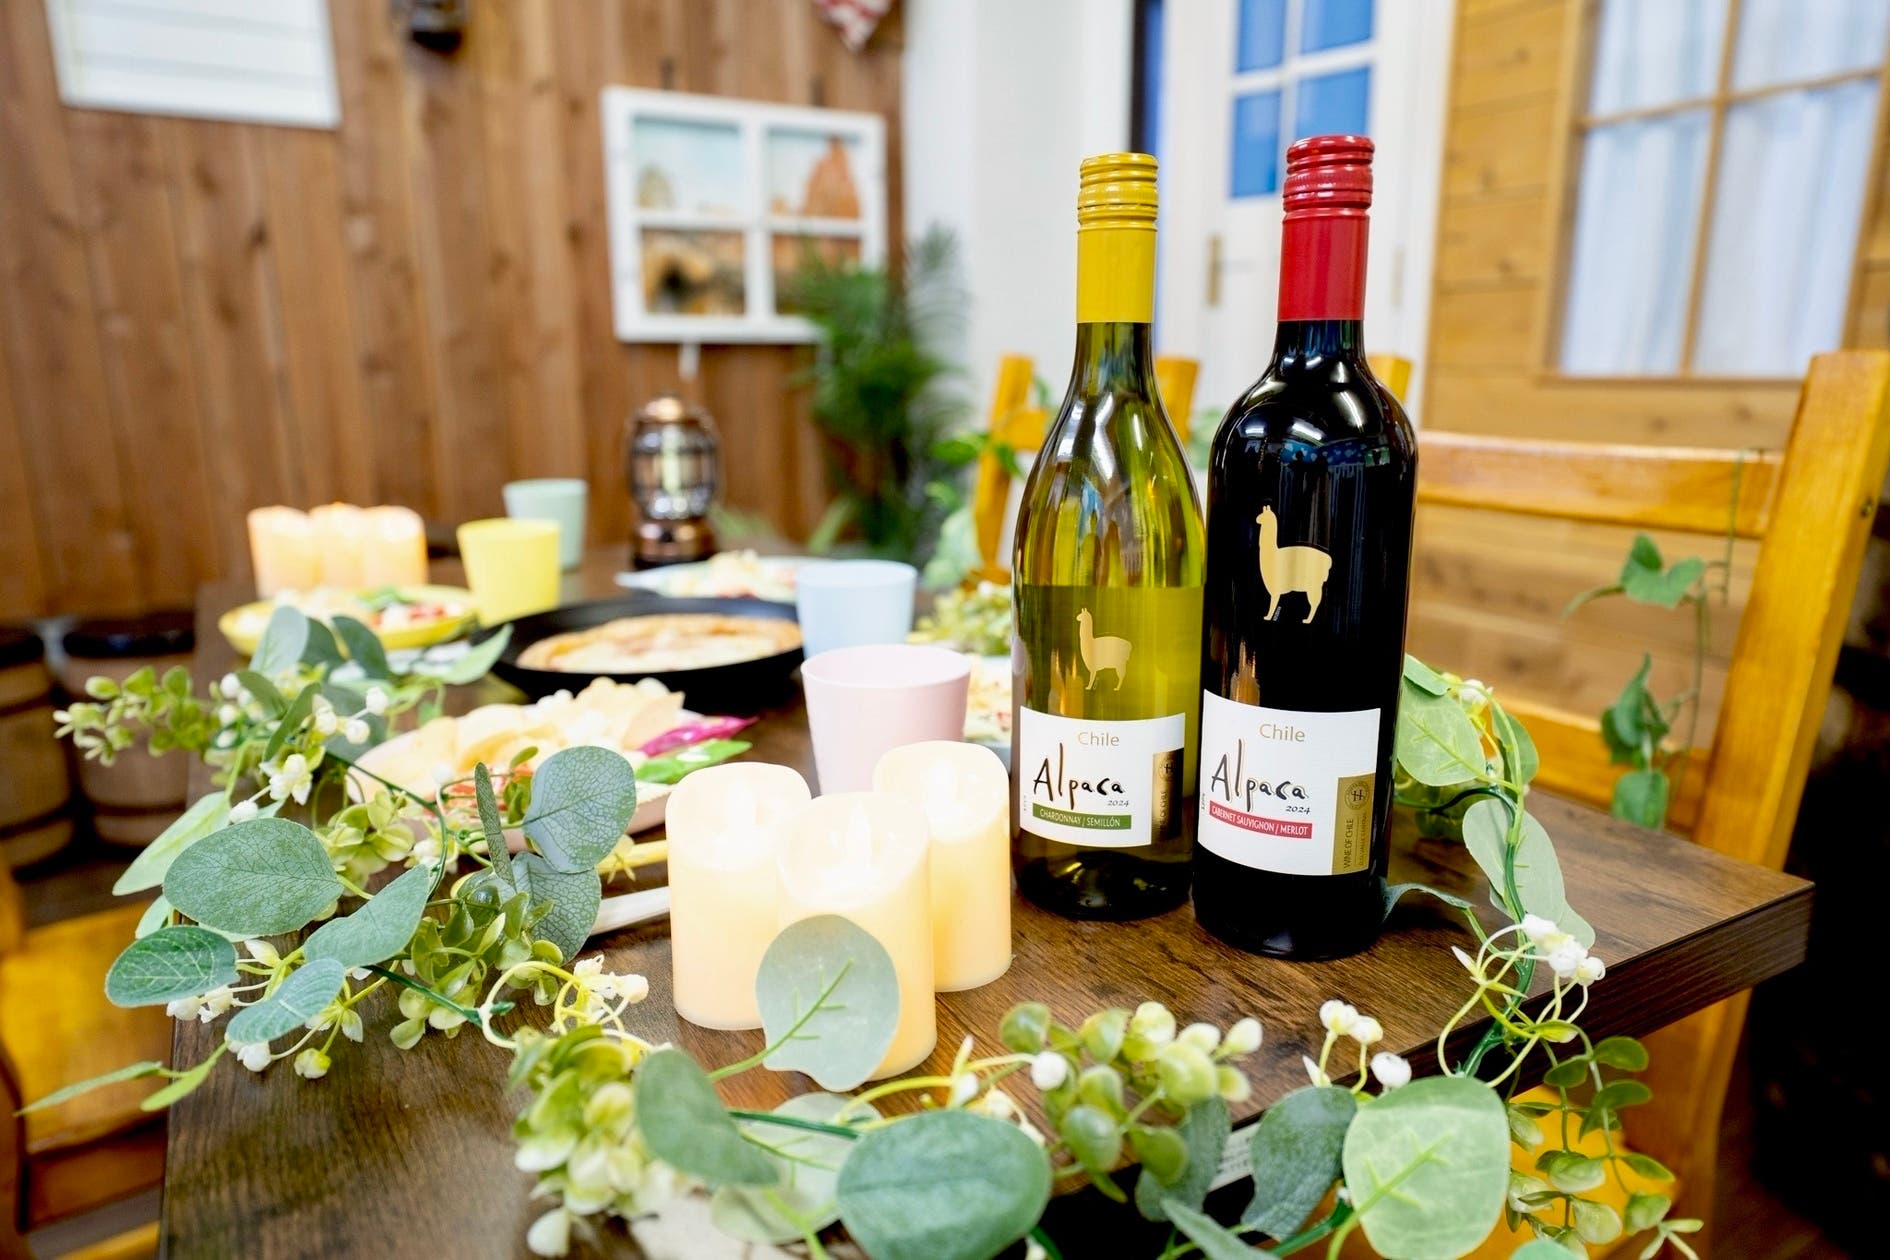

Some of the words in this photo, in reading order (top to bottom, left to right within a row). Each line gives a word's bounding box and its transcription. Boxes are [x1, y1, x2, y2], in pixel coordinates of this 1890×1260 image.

[1078, 731, 1120, 747] Chile
[1258, 723, 1306, 742] Chile
[1033, 742, 1125, 811] Alpaca
[1211, 738, 1308, 812] Alpaca
[1107, 799, 1130, 808] 2024
[1285, 805, 1311, 815] 2024
[1040, 808, 1081, 824] CHARDONNAY
[1086, 816, 1121, 827] SEMILLÓN
[1211, 805, 1236, 822] CABERNET
[1236, 814, 1275, 832] SAUVIGNON
[1280, 823, 1308, 836] MERLOT
[1345, 819, 1354, 838] CHILE
[1344, 839, 1353, 849] OF
[1343, 849, 1352, 868] WINE
